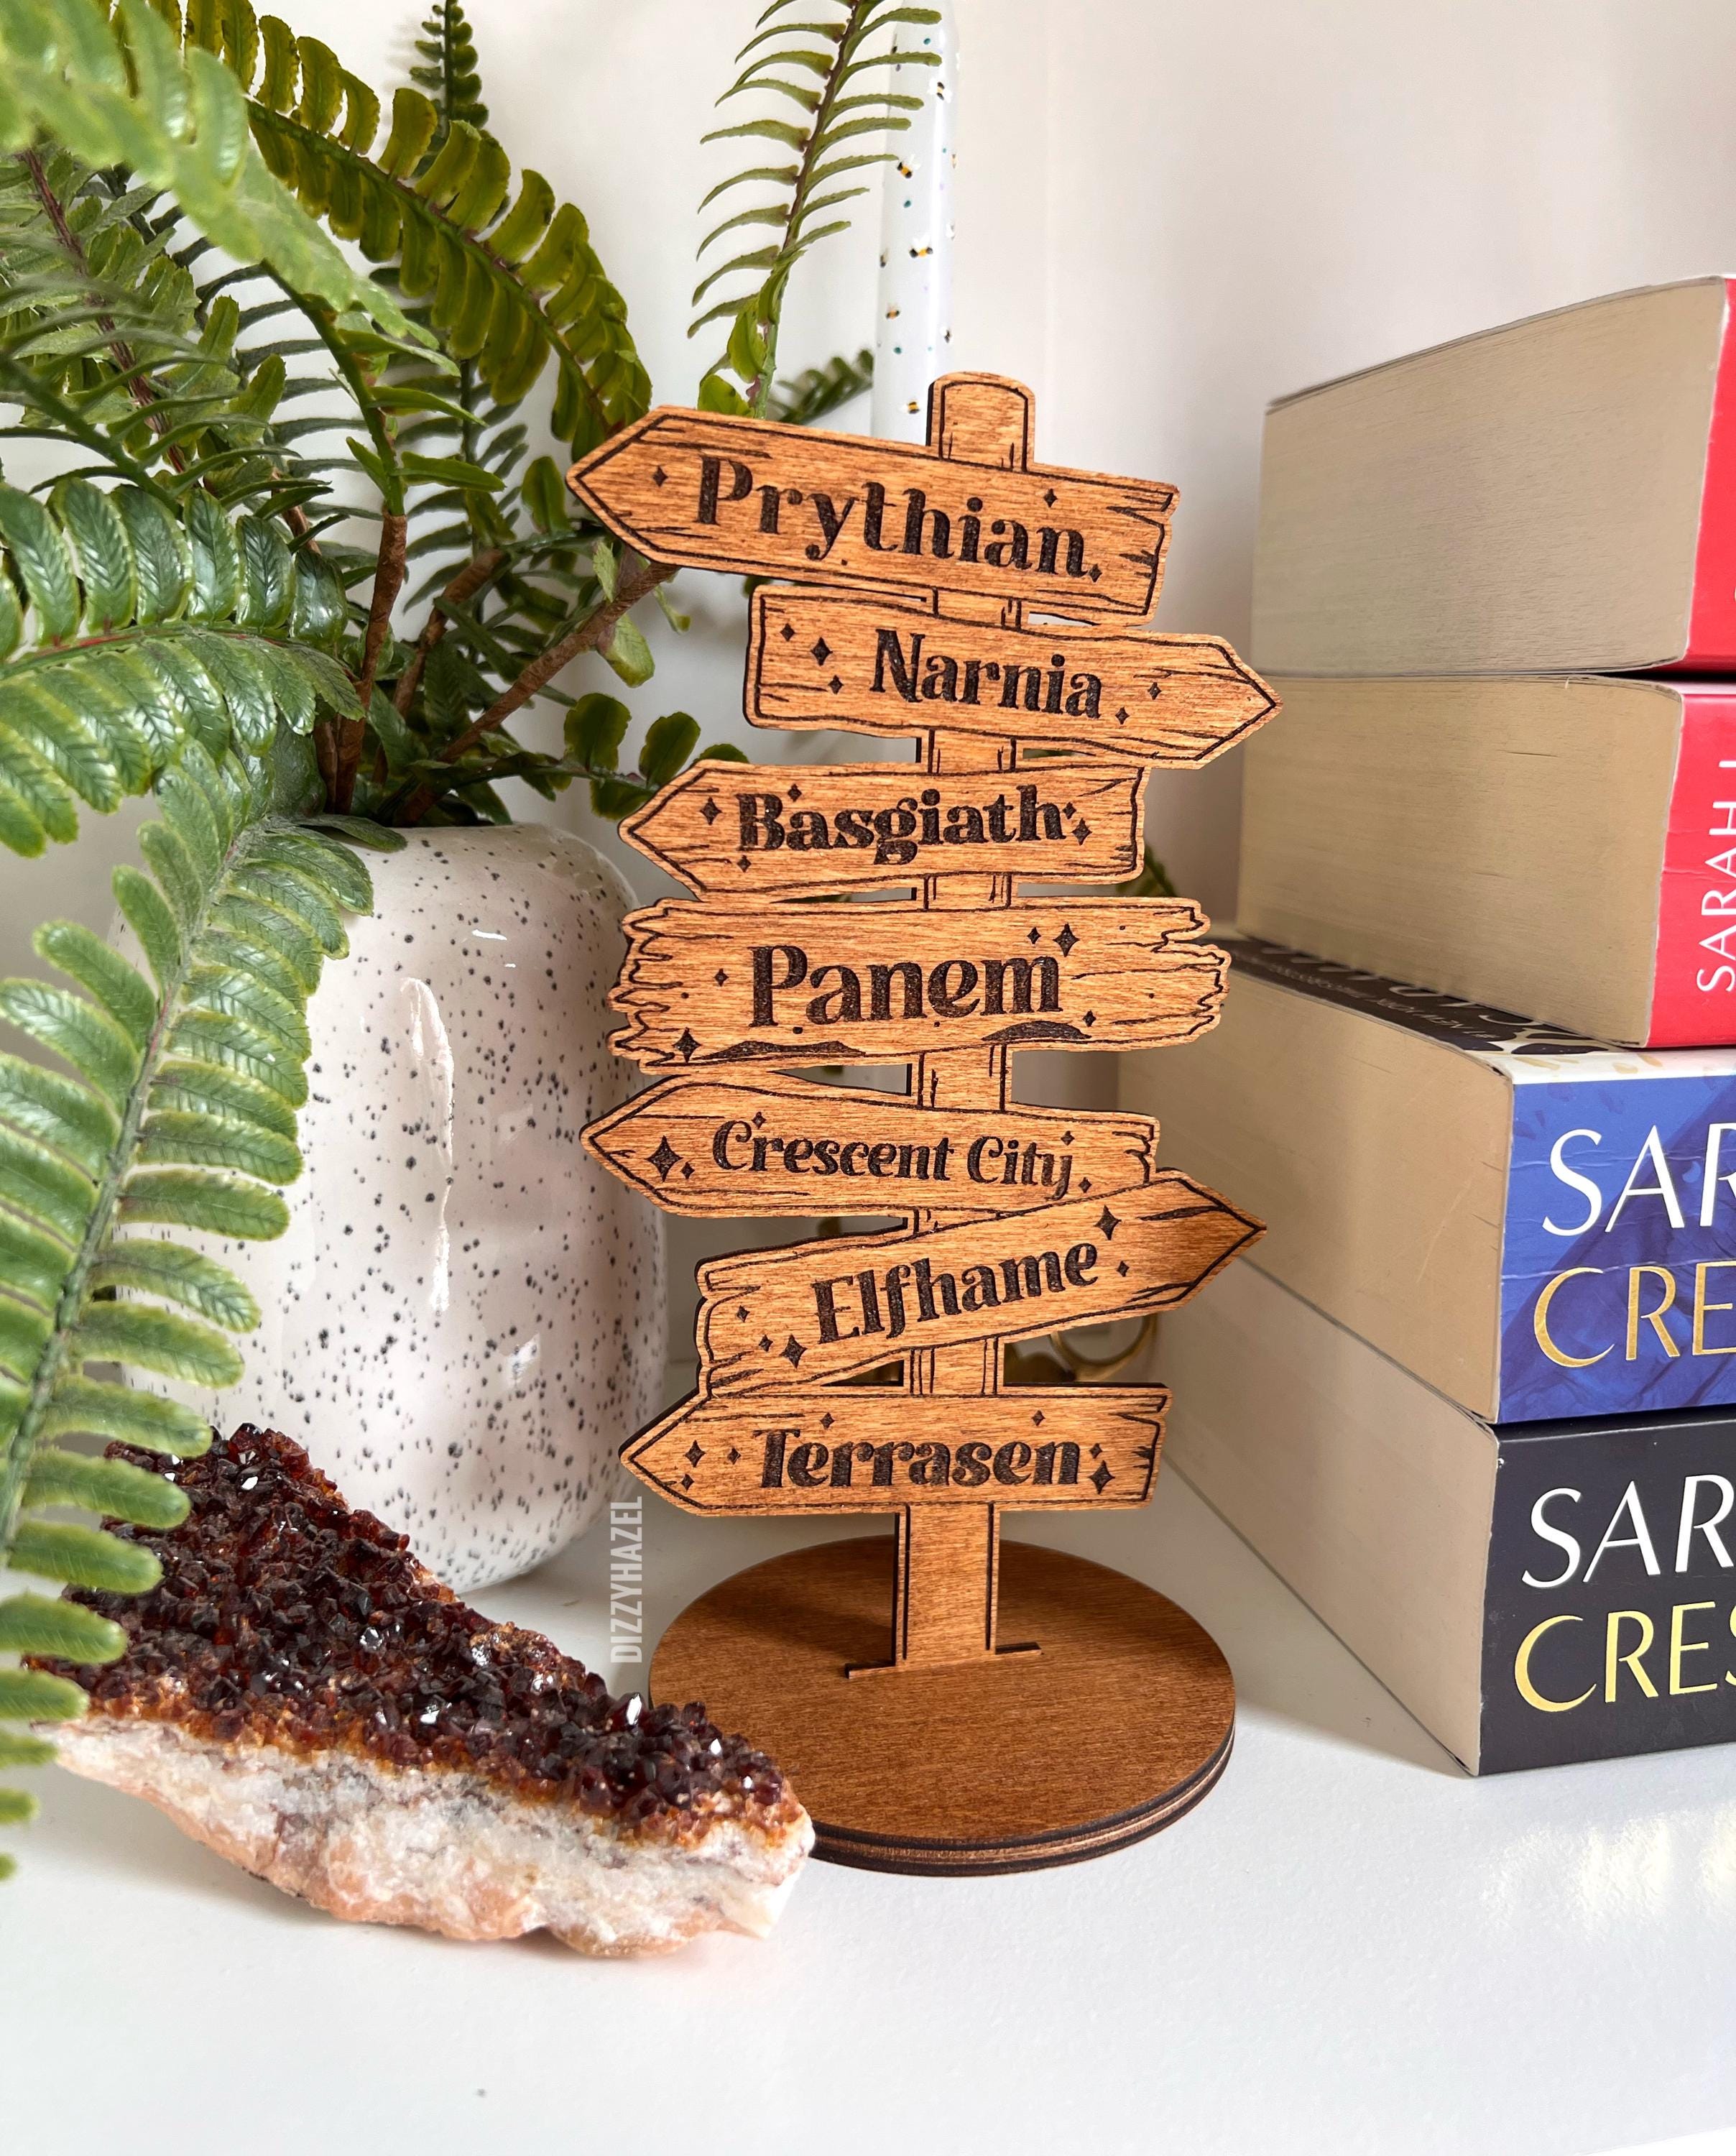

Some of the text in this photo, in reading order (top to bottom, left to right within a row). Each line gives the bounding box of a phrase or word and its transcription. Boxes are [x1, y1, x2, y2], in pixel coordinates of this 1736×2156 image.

[694, 456, 1088, 578] Prythian
[871, 629, 1102, 720] Narnia
[734, 784, 1068, 865] Basgiath
[1696, 799, 1736, 992] SARAH
[748, 945, 1063, 1027] Panem
[711, 1120, 1074, 1202] Crescent City
[1542, 1124, 1736, 1236] SAR
[811, 1242, 1099, 1345] Elfhame
[1533, 1260, 1736, 1368] CRE
[753, 1427, 1083, 1489] Terrasen
[1521, 1474, 1735, 1588] SAR
[1514, 1601, 1736, 1713] CRE
